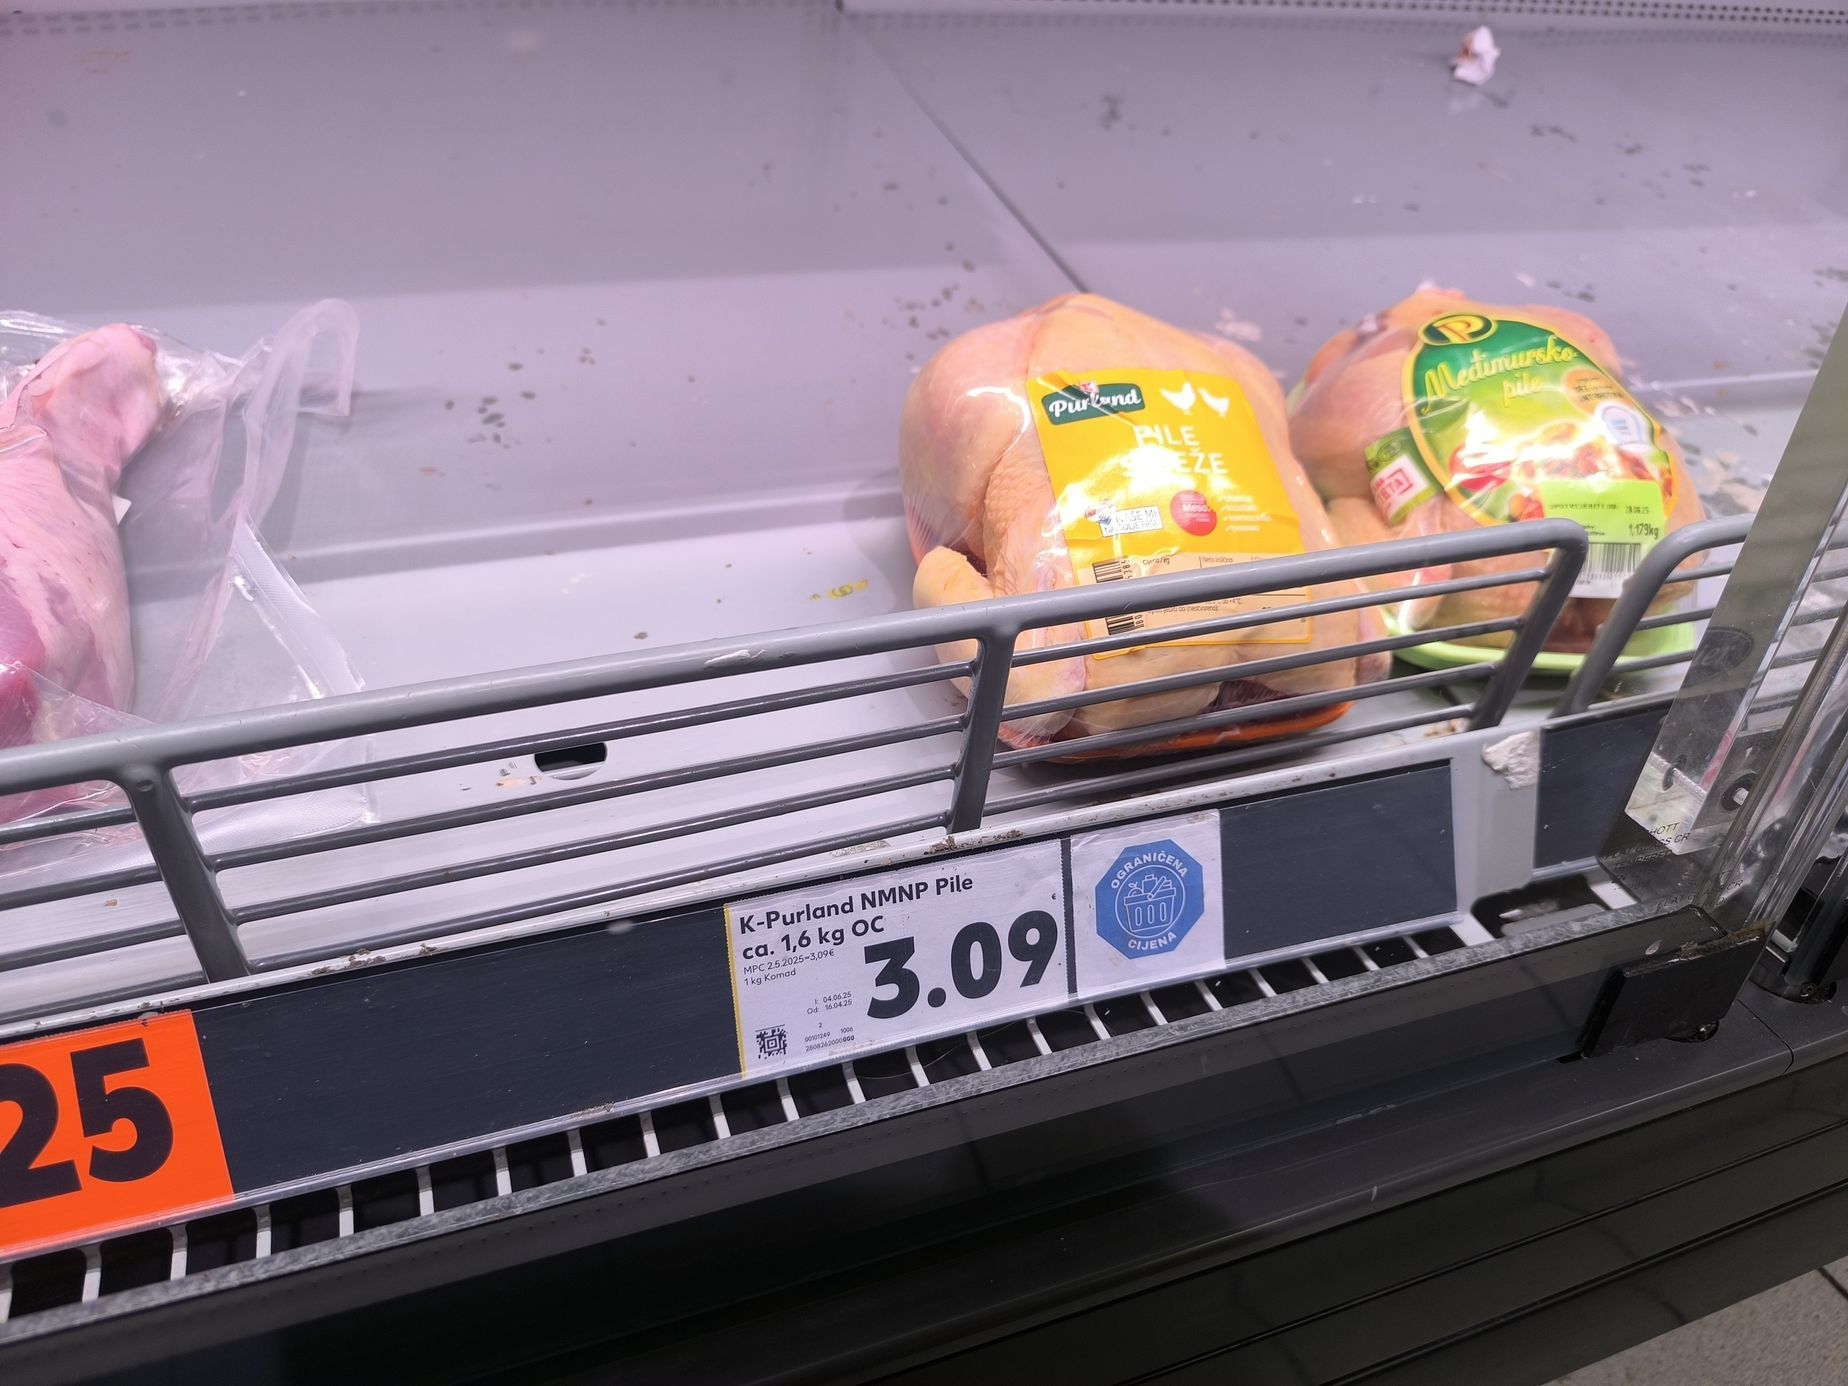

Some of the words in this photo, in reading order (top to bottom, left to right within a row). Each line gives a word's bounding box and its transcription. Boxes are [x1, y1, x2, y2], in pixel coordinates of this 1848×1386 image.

[1503, 371, 1543, 407] pile
[1048, 390, 1142, 418] Purland
[1134, 423, 1201, 447] PILE
[739, 895, 854, 934] K-Purland
[860, 881, 929, 911] NMNP
[935, 875, 974, 895] Pile
[742, 941, 775, 960] ca.
[780, 929, 812, 954] 1,6
[817, 923, 846, 947] kg
[851, 915, 885, 937] OC
[1127, 931, 1178, 950] CIJENA
[743, 961, 766, 975] MPC
[750, 975, 762, 986] kg
[764, 967, 797, 982] Komad
[864, 909, 1059, 1020] 3.09
[822, 991, 852, 1002] 04.06.25
[0, 1037, 174, 1208] 25
